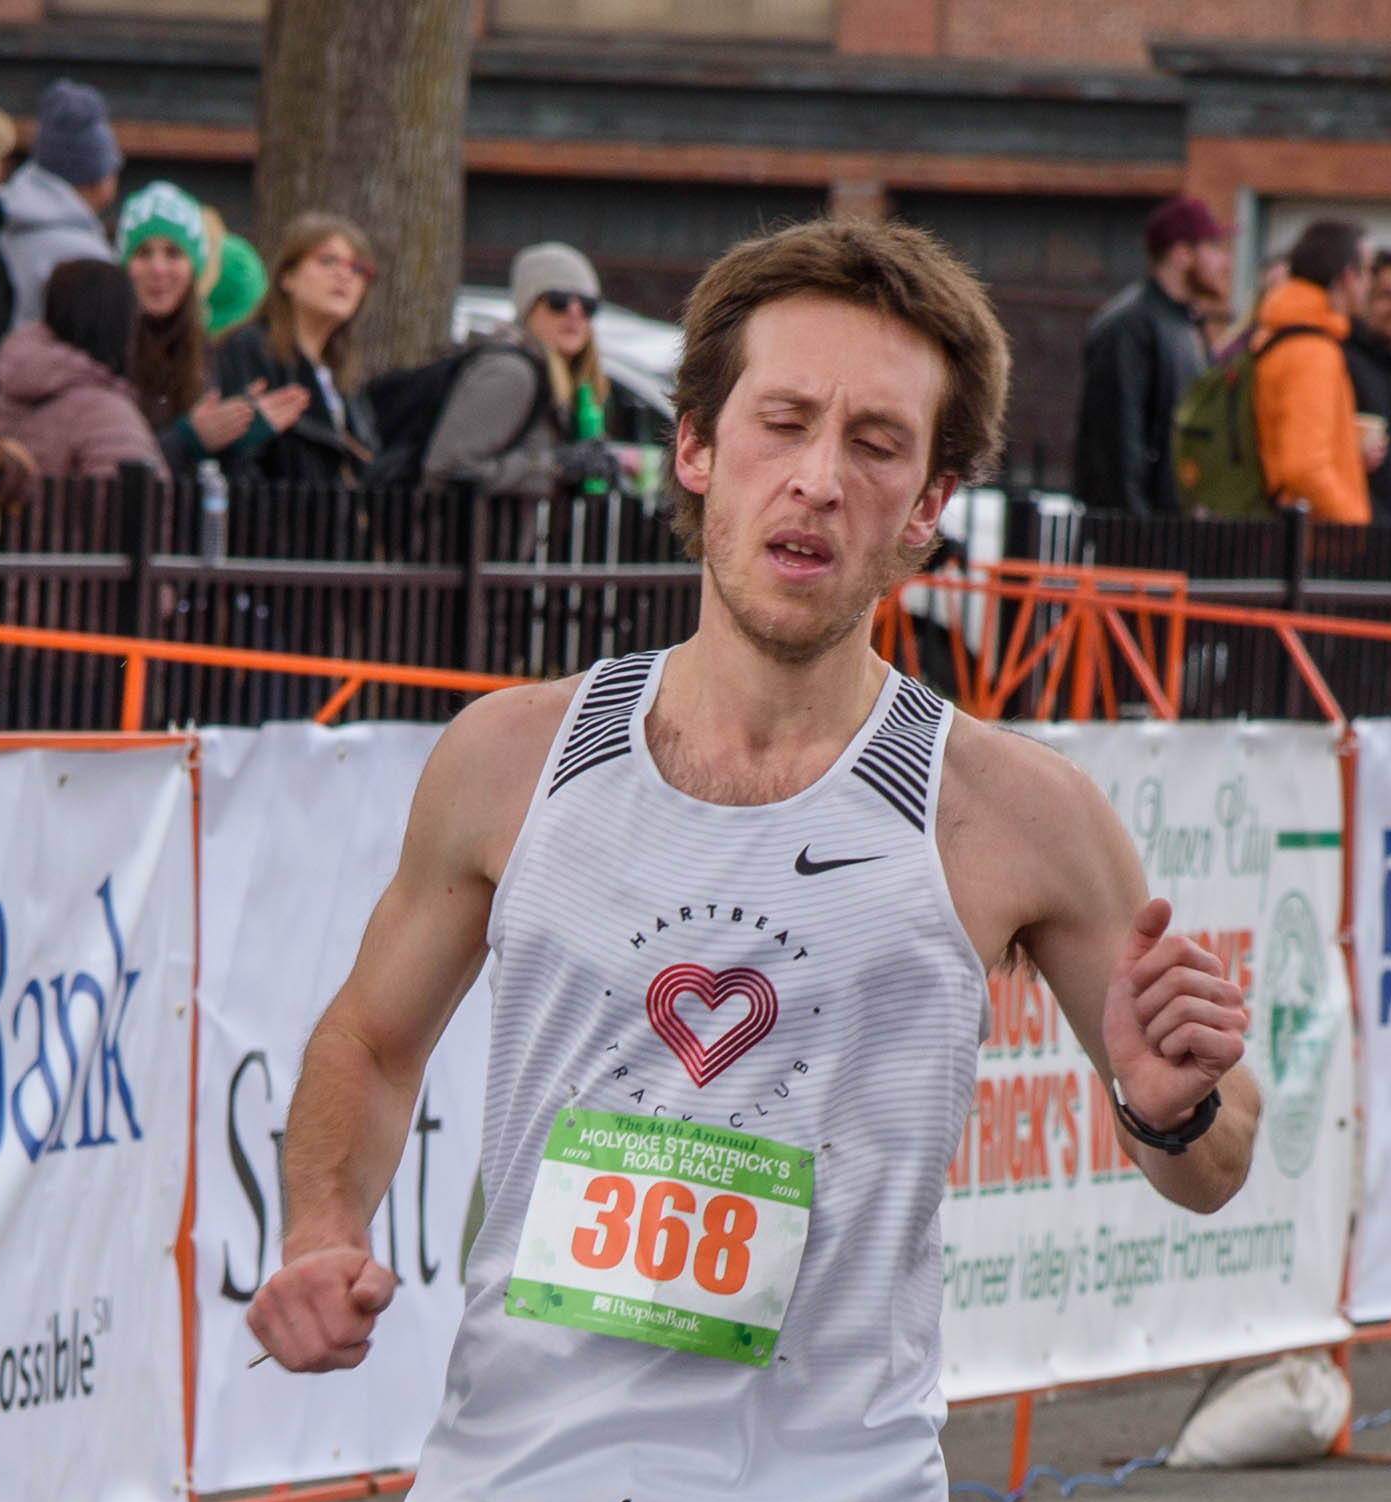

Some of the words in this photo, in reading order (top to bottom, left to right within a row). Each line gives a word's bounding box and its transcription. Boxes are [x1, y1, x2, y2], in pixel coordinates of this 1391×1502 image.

[630, 904, 808, 961] HARTBEAT
[729, 1059, 809, 1129] CLUB
[579, 1128, 661, 1153] HOLYOKE
[663, 1136, 792, 1180] ST.PATRICK'S
[615, 1115, 643, 1132] The
[647, 1118, 685, 1136] 44th
[690, 1124, 759, 1151] Annual
[622, 1150, 674, 1173] ROAD
[677, 1157, 736, 1186] RACE
[771, 1182, 802, 1201] 2019
[570, 1174, 758, 1296] 368
[1171, 1210, 1296, 1284] Homecoming
[611, 1296, 701, 1333] PeoplesBank
